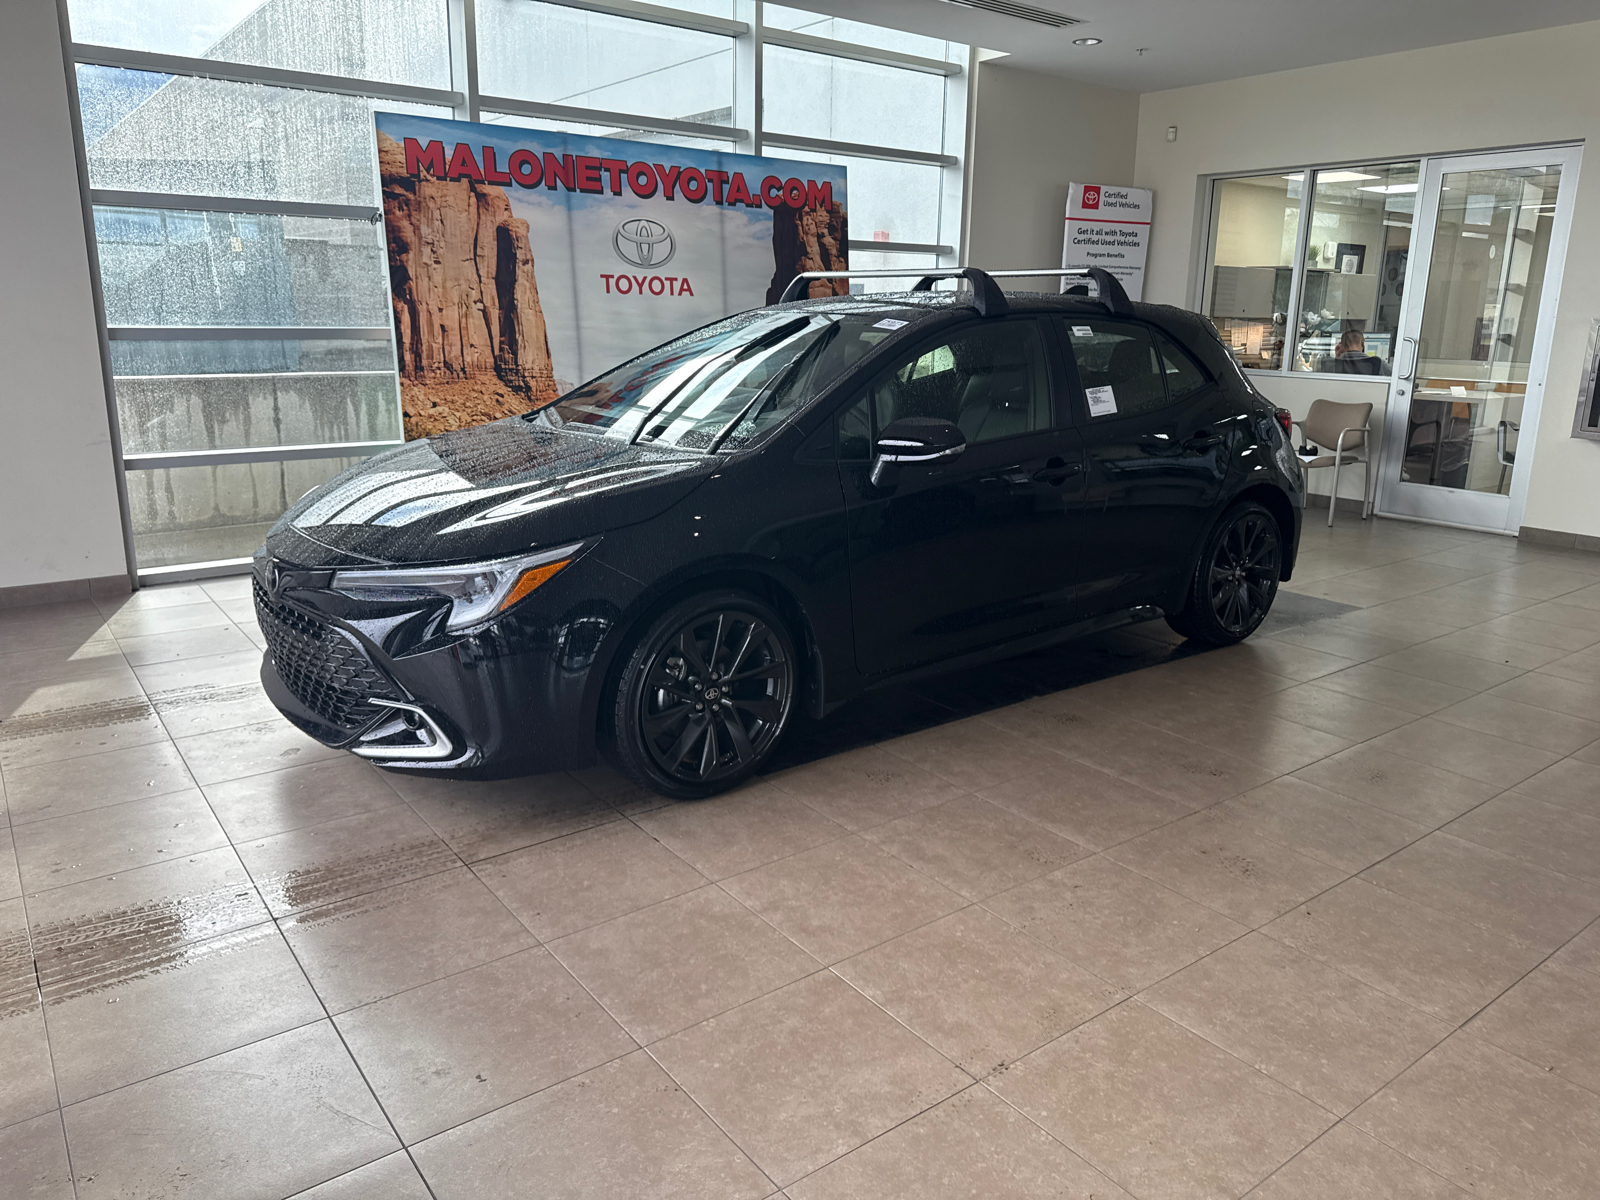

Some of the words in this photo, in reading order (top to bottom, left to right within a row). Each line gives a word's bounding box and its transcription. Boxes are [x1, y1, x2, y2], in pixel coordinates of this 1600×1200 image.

[403, 137, 833, 212] MALONETOYOTA.COM
[1103, 191, 1128, 200] Certified
[1118, 201, 1140, 210] Vehicles
[1077, 227, 1089, 235] Get
[1095, 228, 1103, 236] all
[1104, 229, 1117, 237] with
[1118, 230, 1138, 239] Toyota
[1072, 237, 1099, 246] Certified
[1116, 239, 1140, 247] Vehicles
[600, 274, 694, 296] TOYOTA
